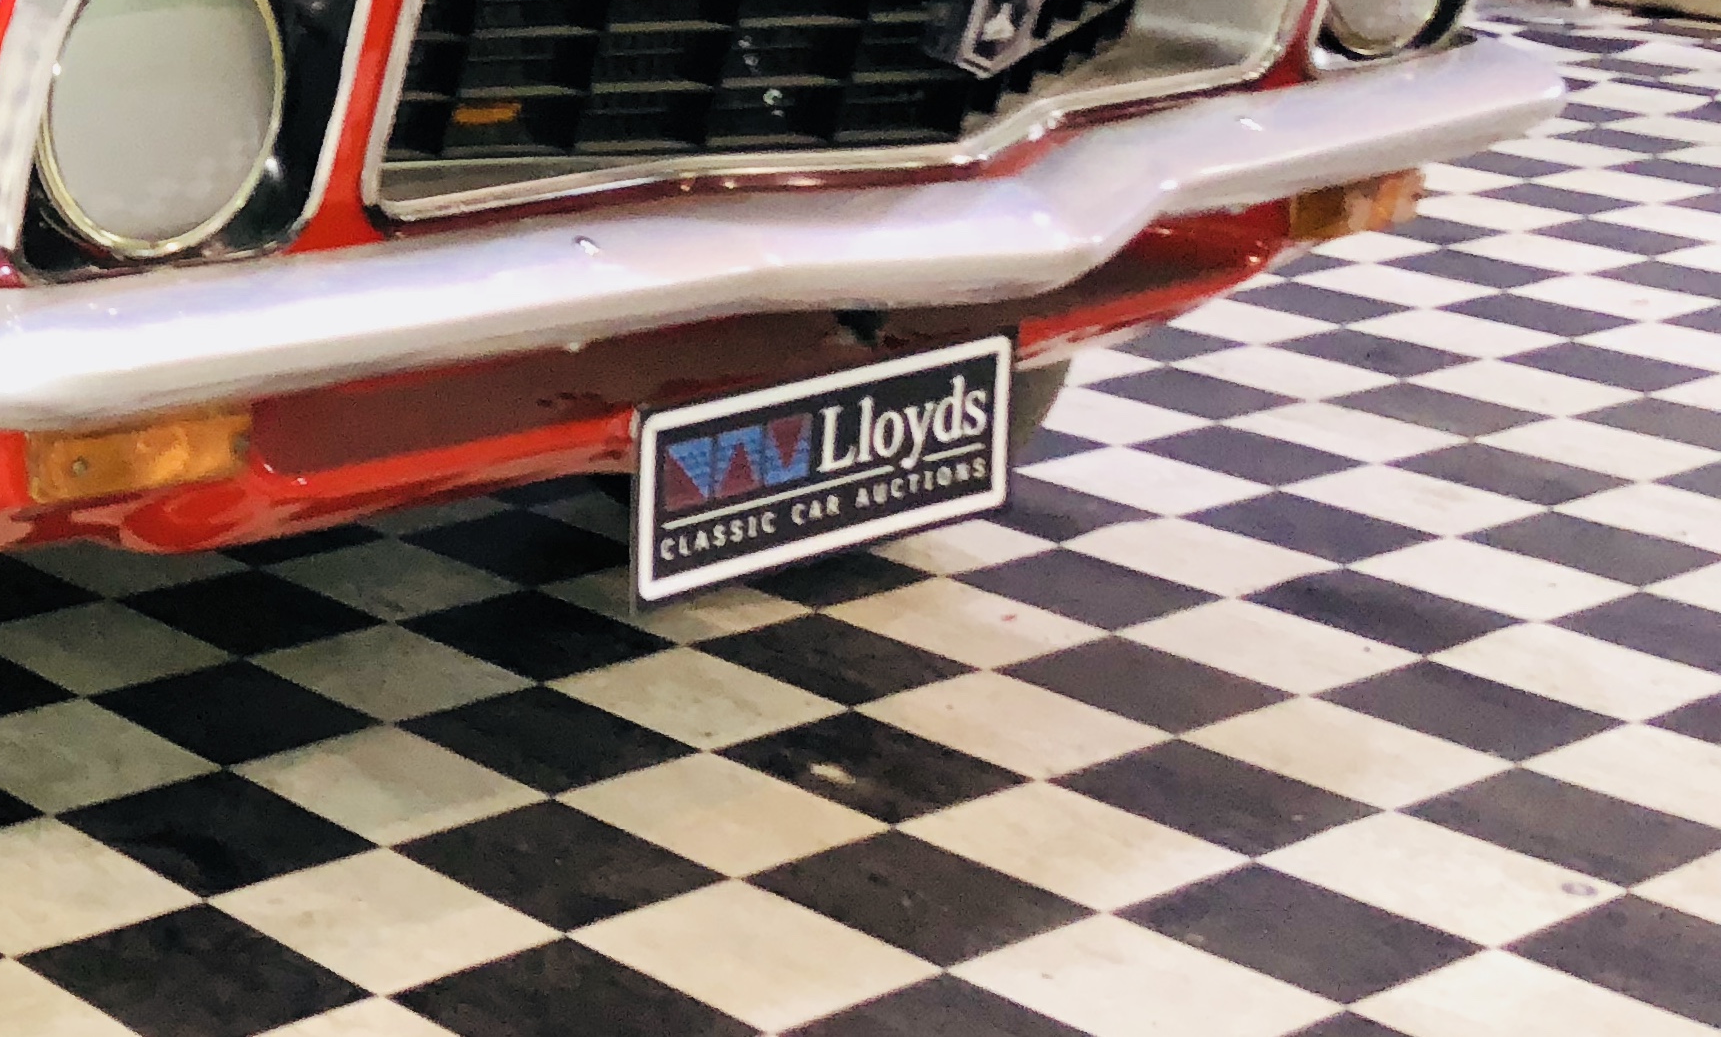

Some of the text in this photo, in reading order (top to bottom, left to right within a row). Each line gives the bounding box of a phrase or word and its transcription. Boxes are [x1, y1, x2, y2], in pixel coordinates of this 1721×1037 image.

[817, 374, 987, 473] Lloyds
[660, 457, 987, 562] CLASSIC CAR AUCTIONS
